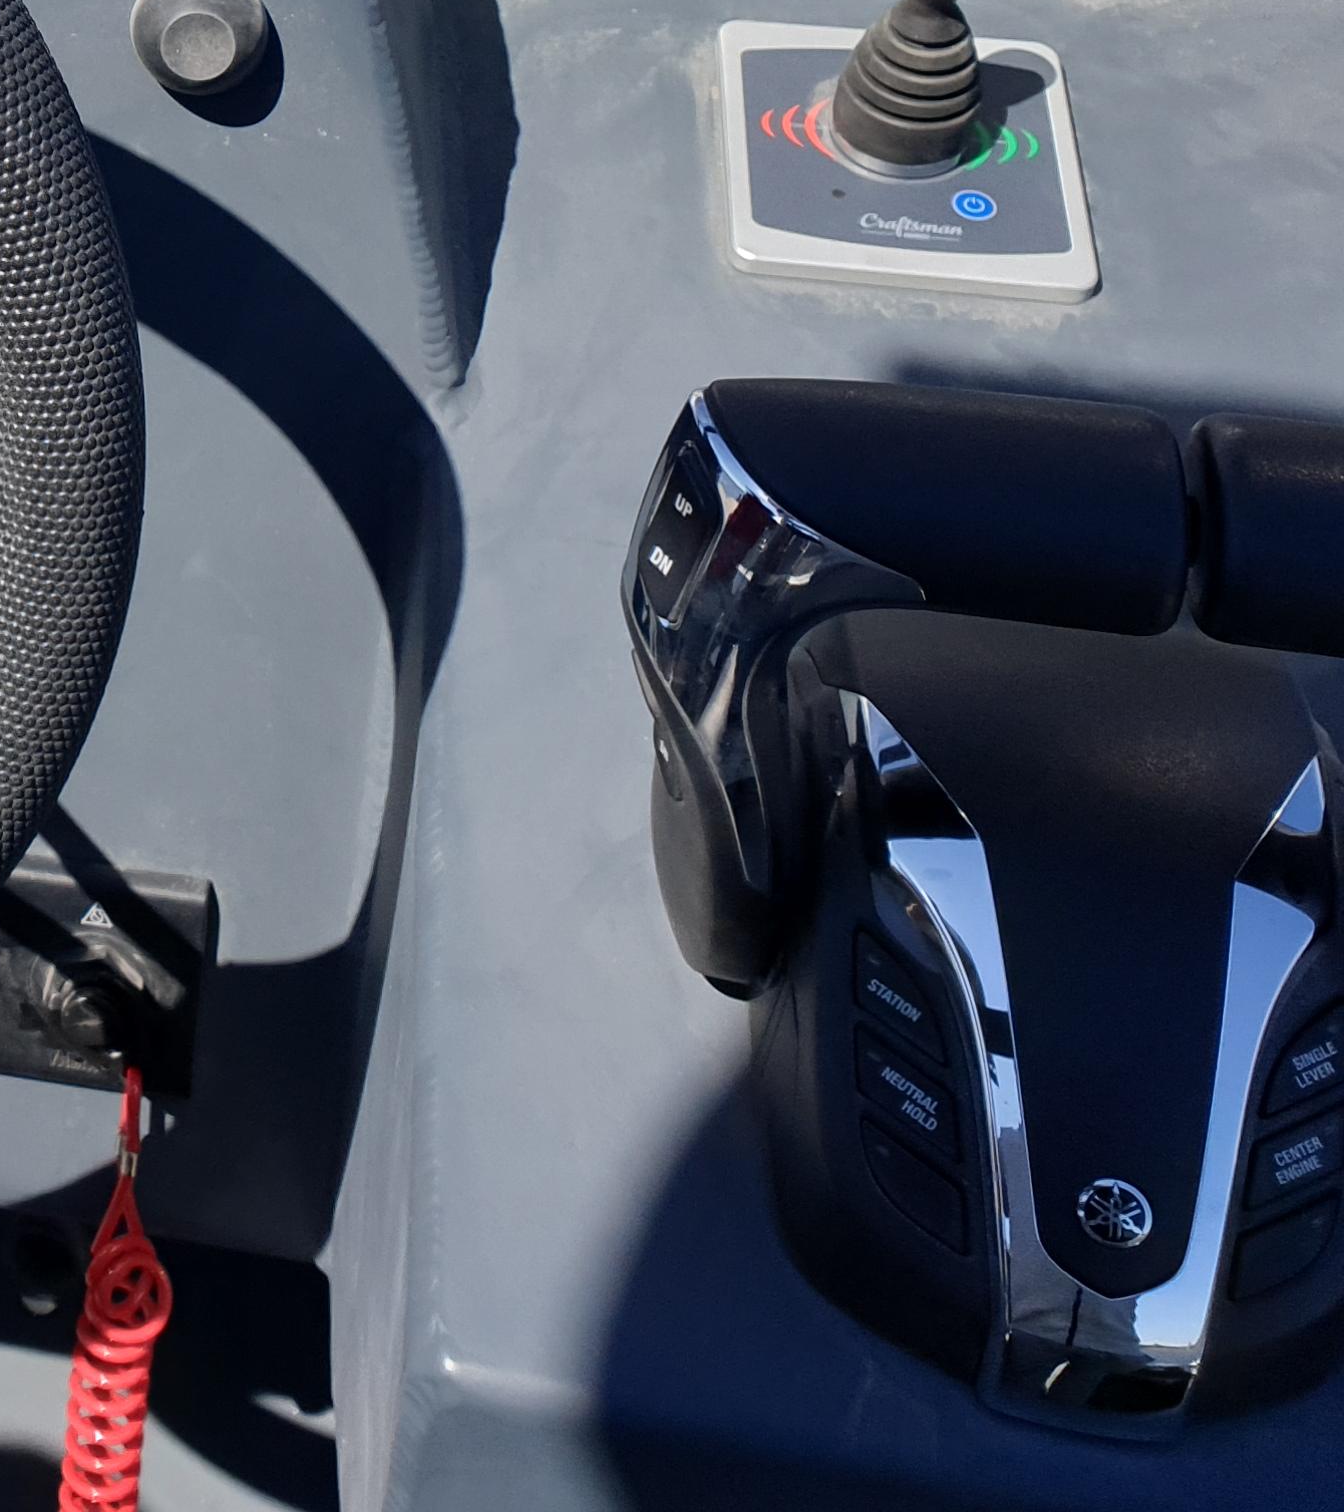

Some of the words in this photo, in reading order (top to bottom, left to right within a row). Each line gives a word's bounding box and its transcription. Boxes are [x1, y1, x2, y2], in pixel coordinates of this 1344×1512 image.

[860, 212, 963, 238] Craftsman
[674, 492, 694, 518] UP
[648, 545, 674, 577] DN
[867, 978, 922, 1023] STATION
[1292, 1041, 1339, 1072] SINGLE
[1295, 1061, 1335, 1089] LEVER
[880, 1066, 939, 1116] NEUTRAL
[901, 1099, 939, 1132] HOLD
[1274, 1136, 1325, 1167] CENTER
[1275, 1154, 1324, 1185] ENGINE
